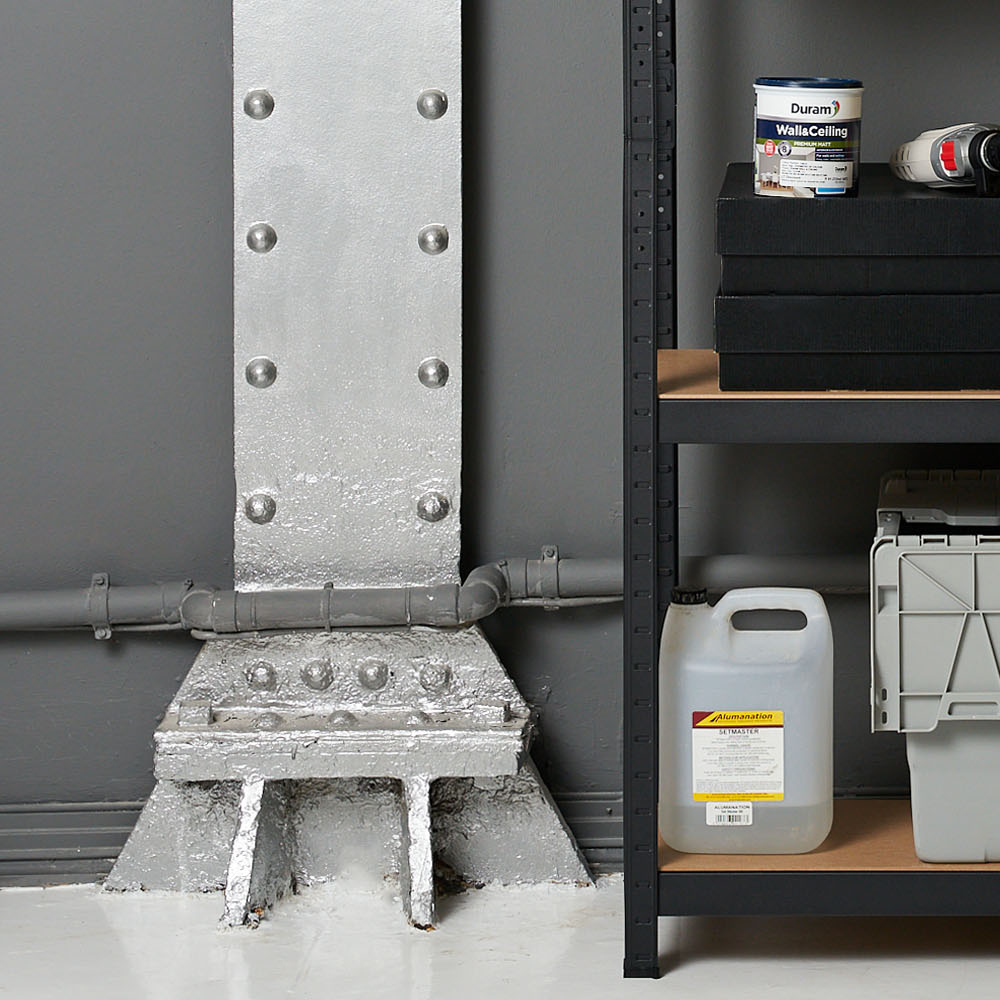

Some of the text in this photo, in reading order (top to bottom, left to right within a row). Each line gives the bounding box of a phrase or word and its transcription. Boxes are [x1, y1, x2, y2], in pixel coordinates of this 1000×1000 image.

[791, 103, 832, 115] Duram
[776, 124, 848, 139] Wall&Ceiling
[714, 712, 774, 722] Alumanation
